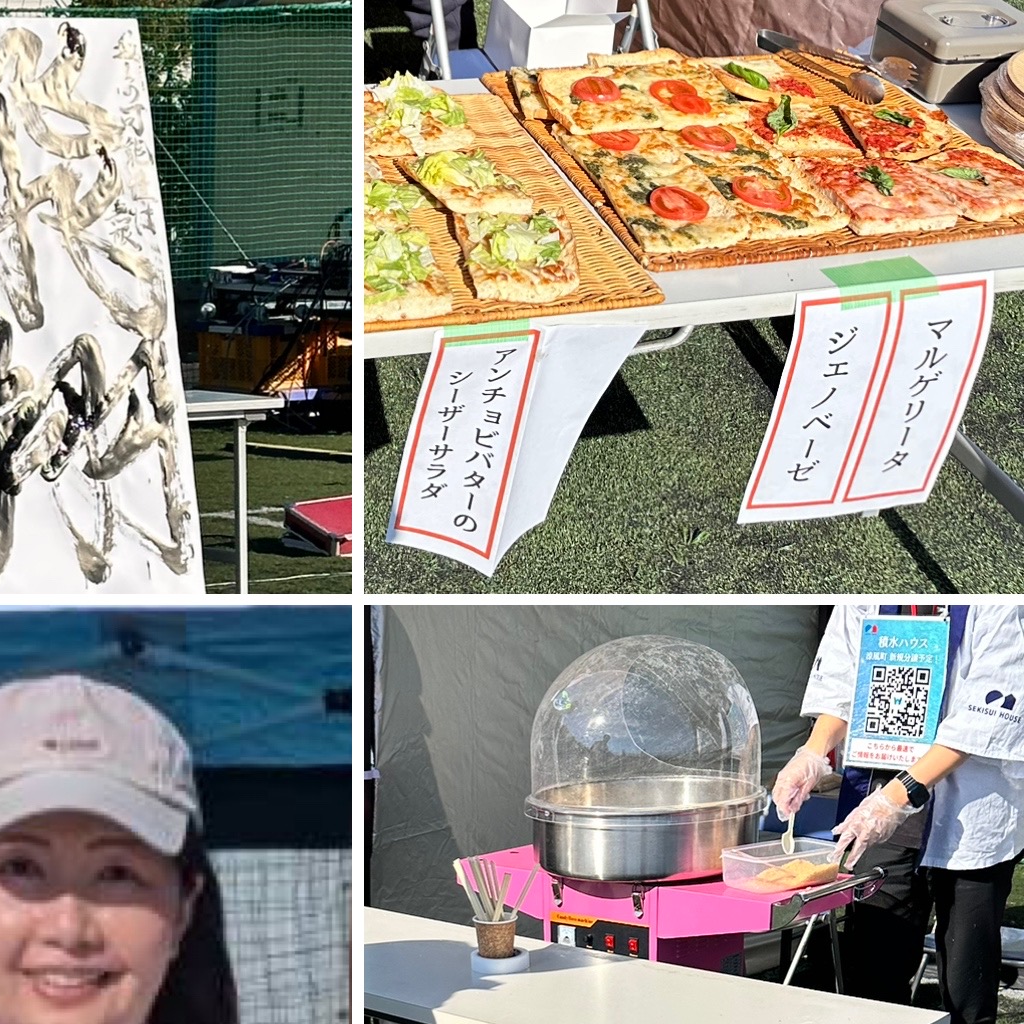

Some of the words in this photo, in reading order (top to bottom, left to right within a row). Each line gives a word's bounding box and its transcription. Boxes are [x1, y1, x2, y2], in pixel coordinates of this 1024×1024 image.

[421, 370, 467, 501] シーザーサラダ
[453, 348, 517, 533] アンチョビバターの
[882, 318, 954, 474] マルゲリータ
[878, 635, 929, 649] 積水ハウス
[967, 704, 997, 717] SEKISUI
[998, 711, 1022, 725] HOUSE
